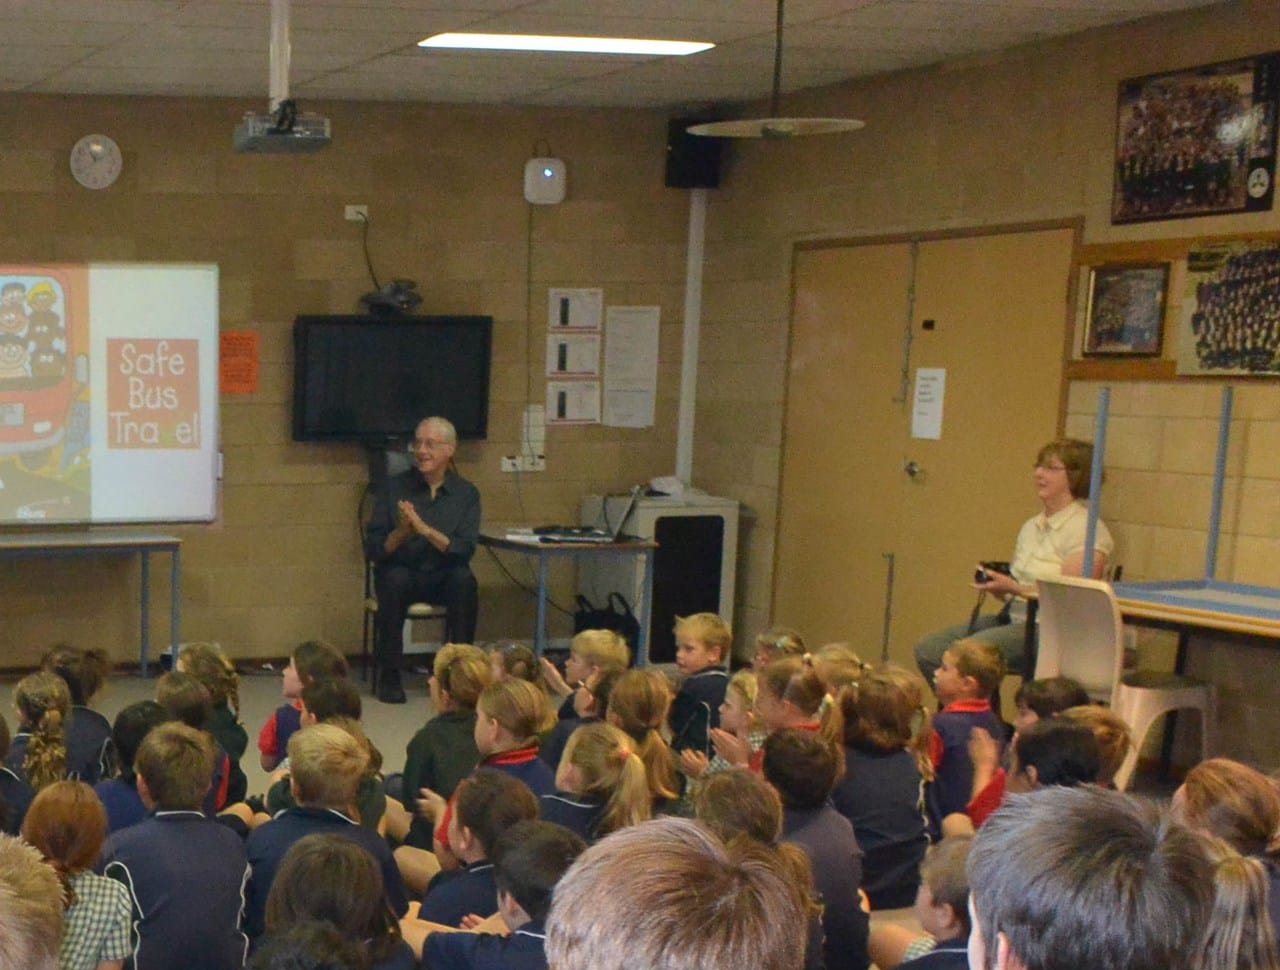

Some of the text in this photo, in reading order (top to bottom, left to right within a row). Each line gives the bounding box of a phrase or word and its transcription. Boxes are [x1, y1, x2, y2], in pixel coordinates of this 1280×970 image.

[120, 340, 186, 377] Safe
[128, 376, 178, 410] Bus
[109, 411, 199, 445] Trael
